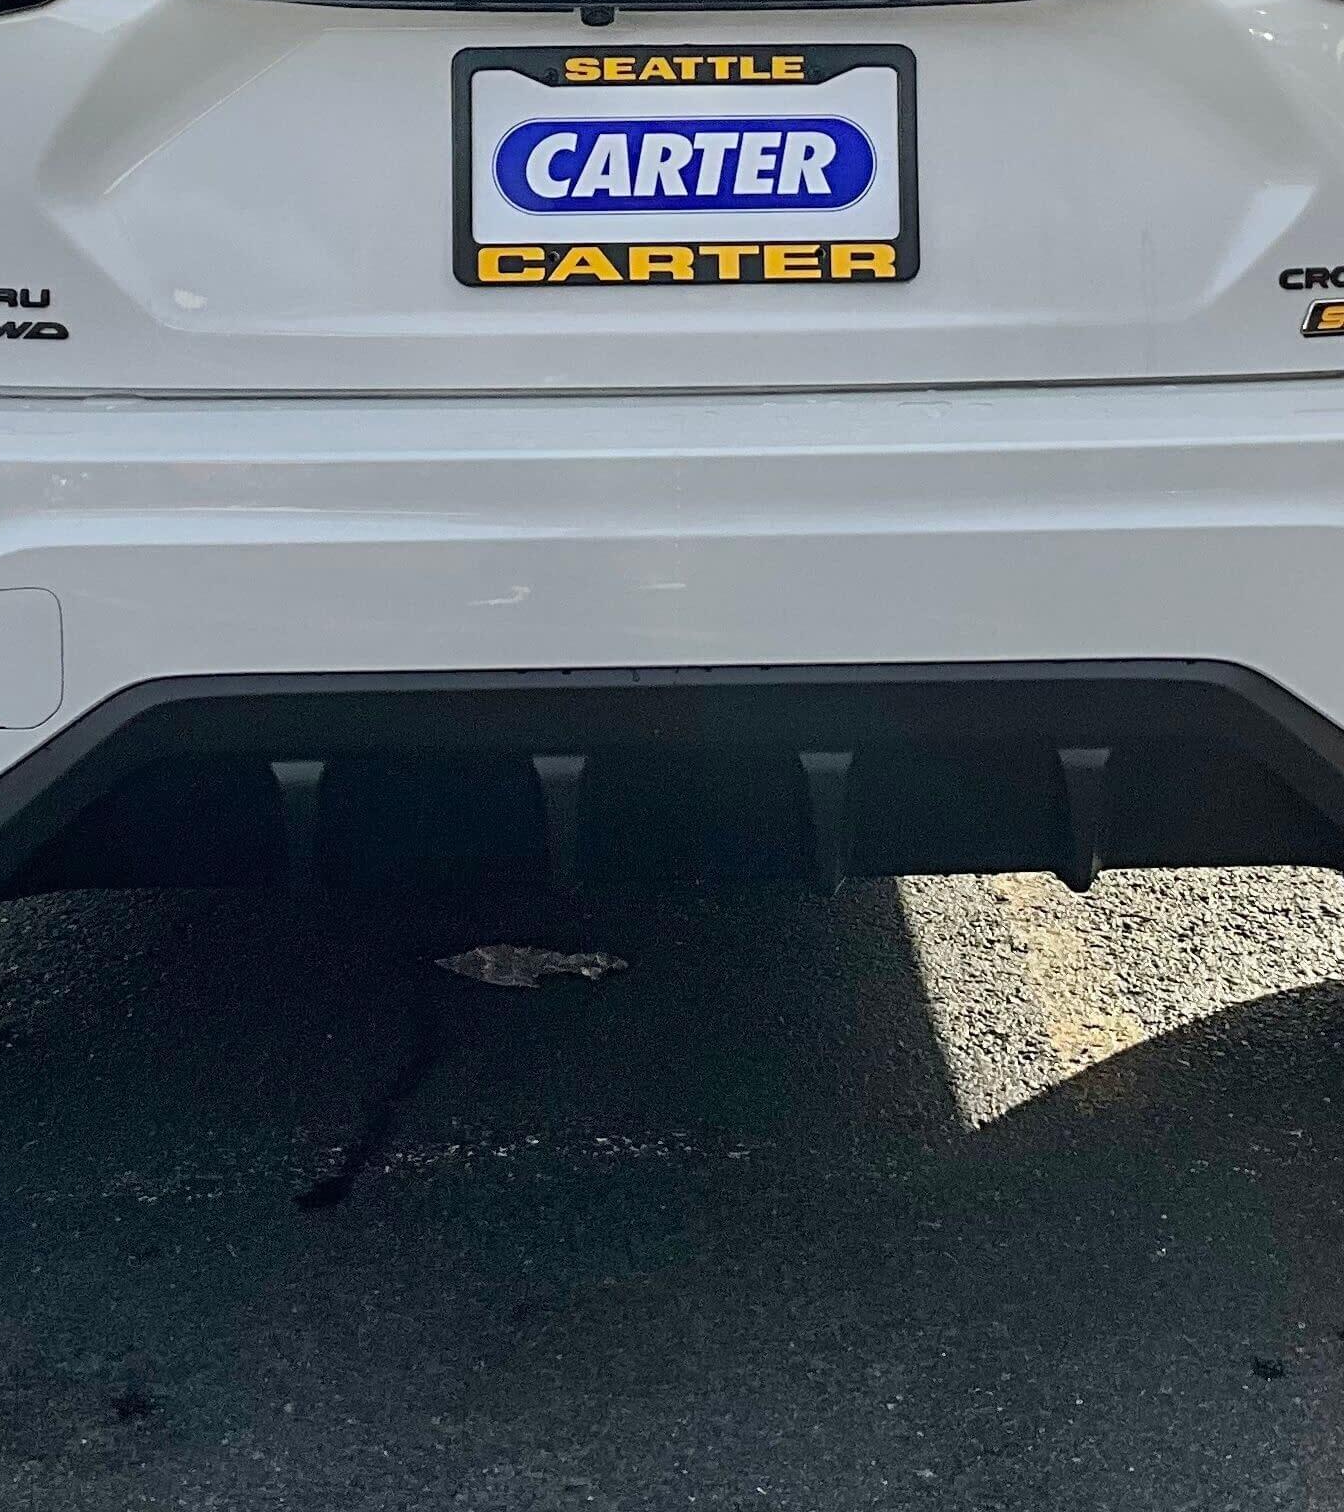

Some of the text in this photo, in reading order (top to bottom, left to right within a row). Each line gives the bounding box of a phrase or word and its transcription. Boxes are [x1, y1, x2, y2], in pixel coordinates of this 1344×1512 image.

[565, 55, 806, 82] SEATTLE
[525, 130, 837, 199] CARTER
[476, 244, 897, 283] CARTER
